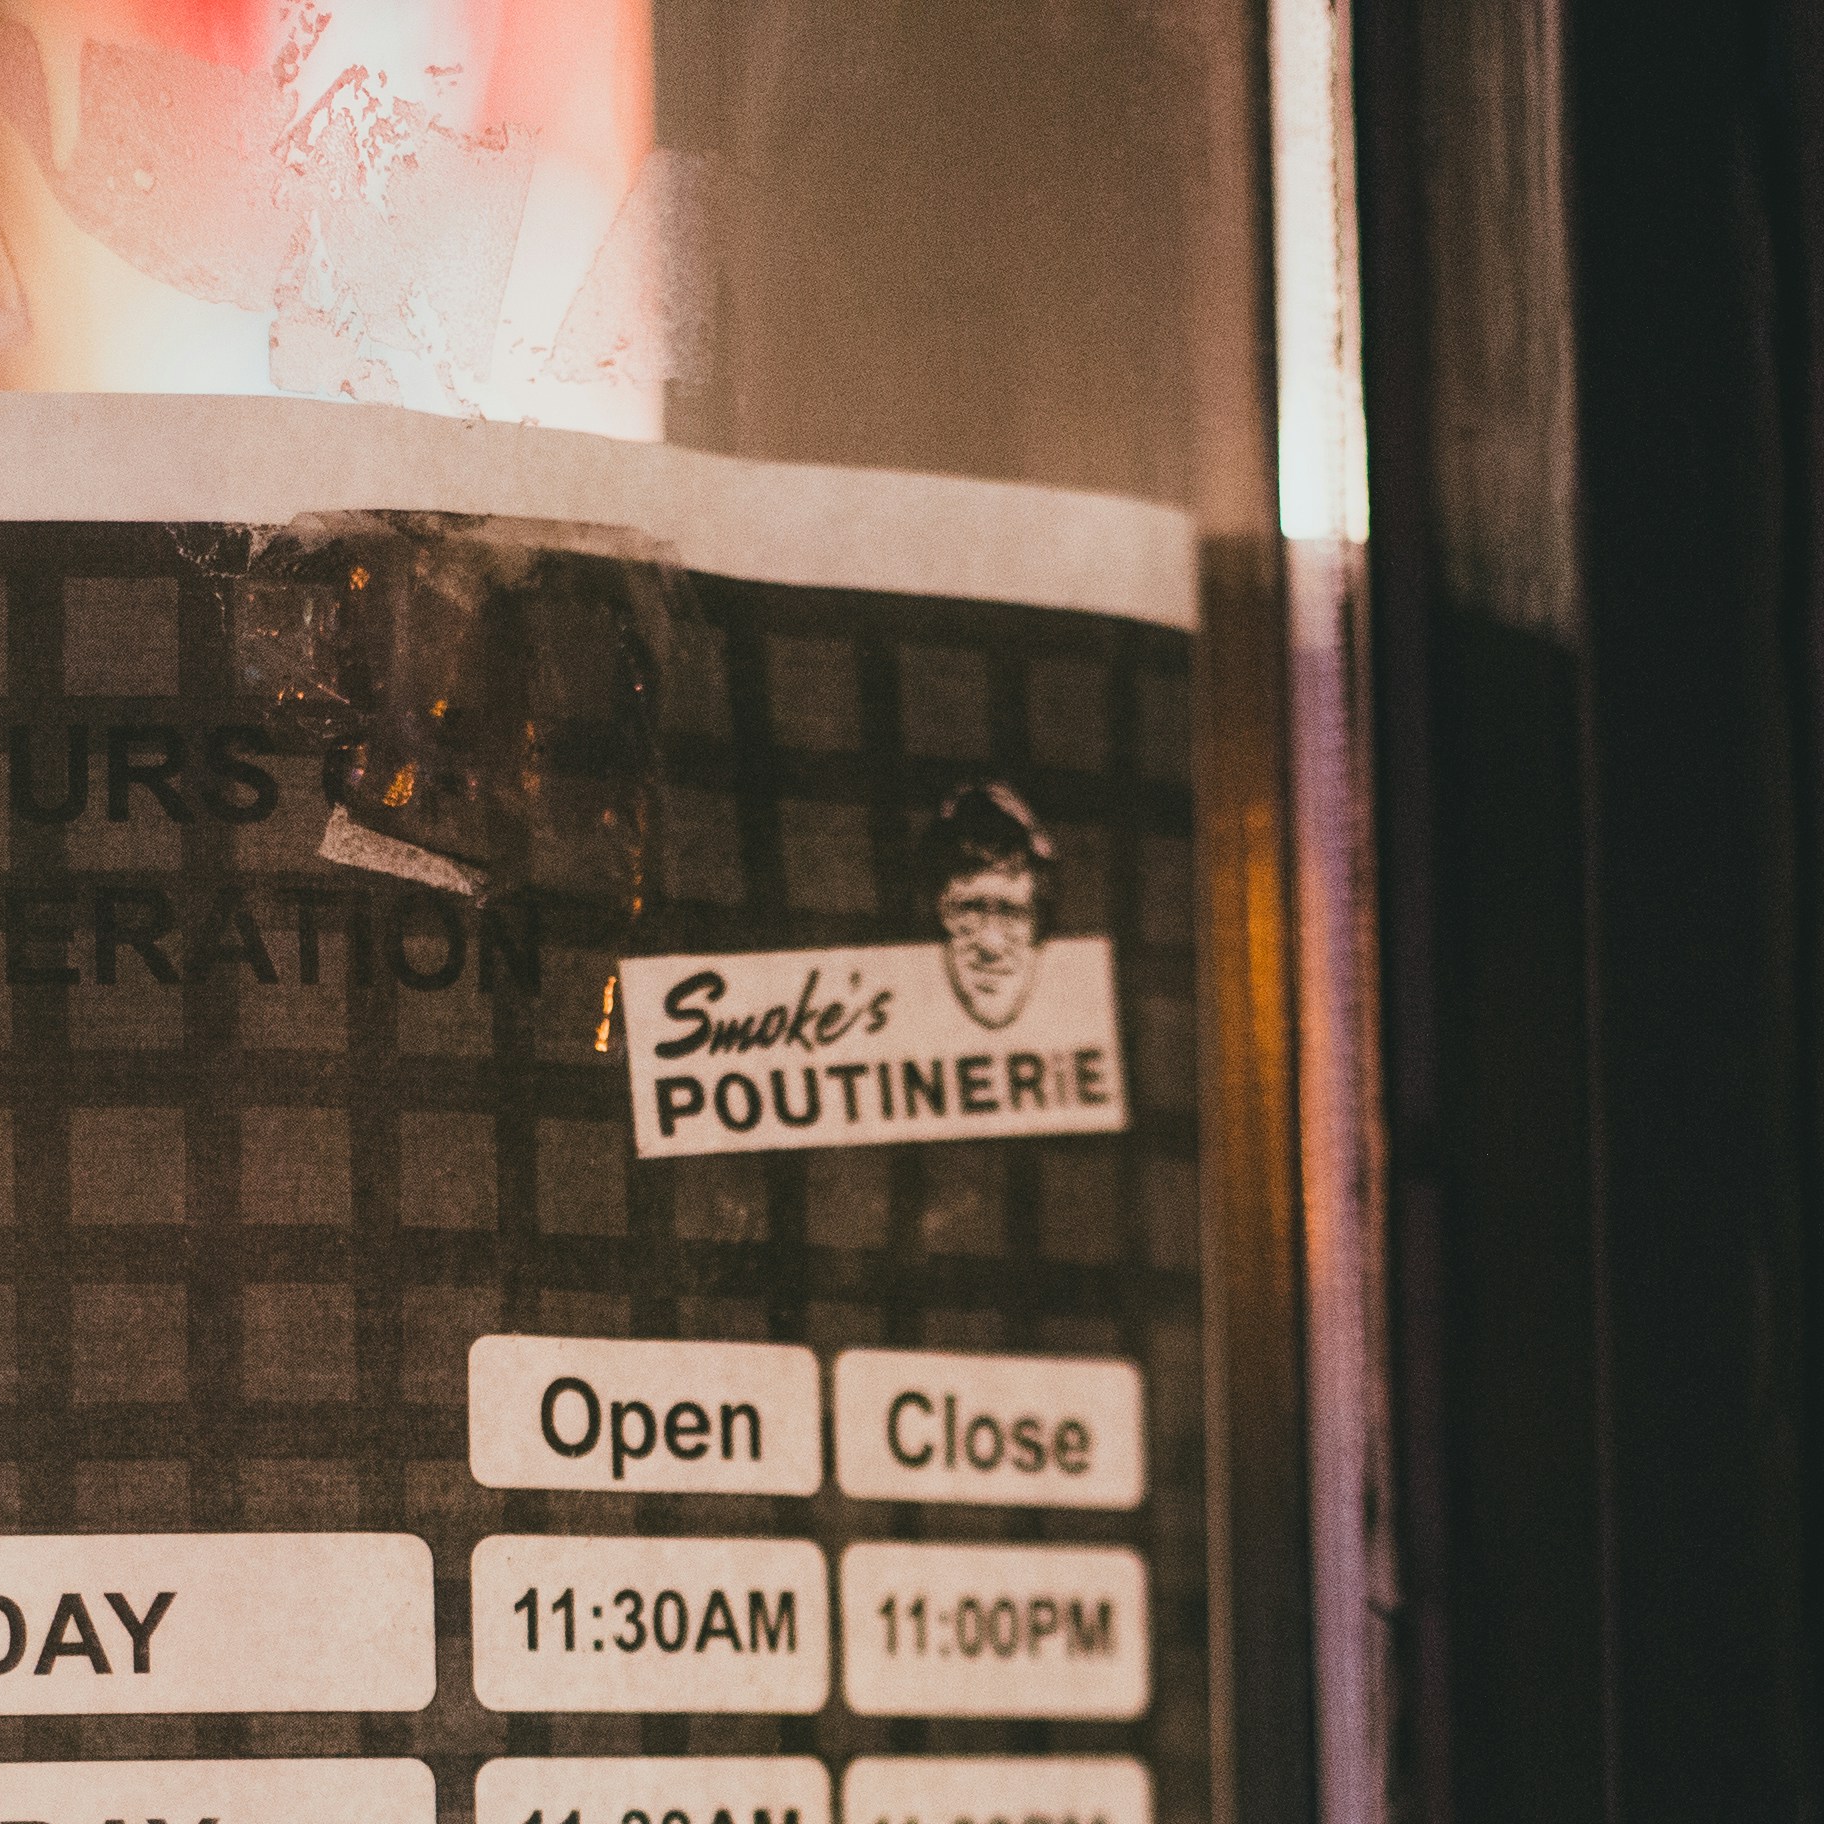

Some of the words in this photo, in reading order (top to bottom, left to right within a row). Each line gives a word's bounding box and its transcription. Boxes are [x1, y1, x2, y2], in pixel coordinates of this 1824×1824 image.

[654, 968, 894, 1060] Smoke's
[540, 1376, 762, 1480] Open
[886, 1389, 1091, 1476] Close
[514, 1588, 797, 1654] 11:30AM
[879, 1596, 1115, 1659] 11:00PM
